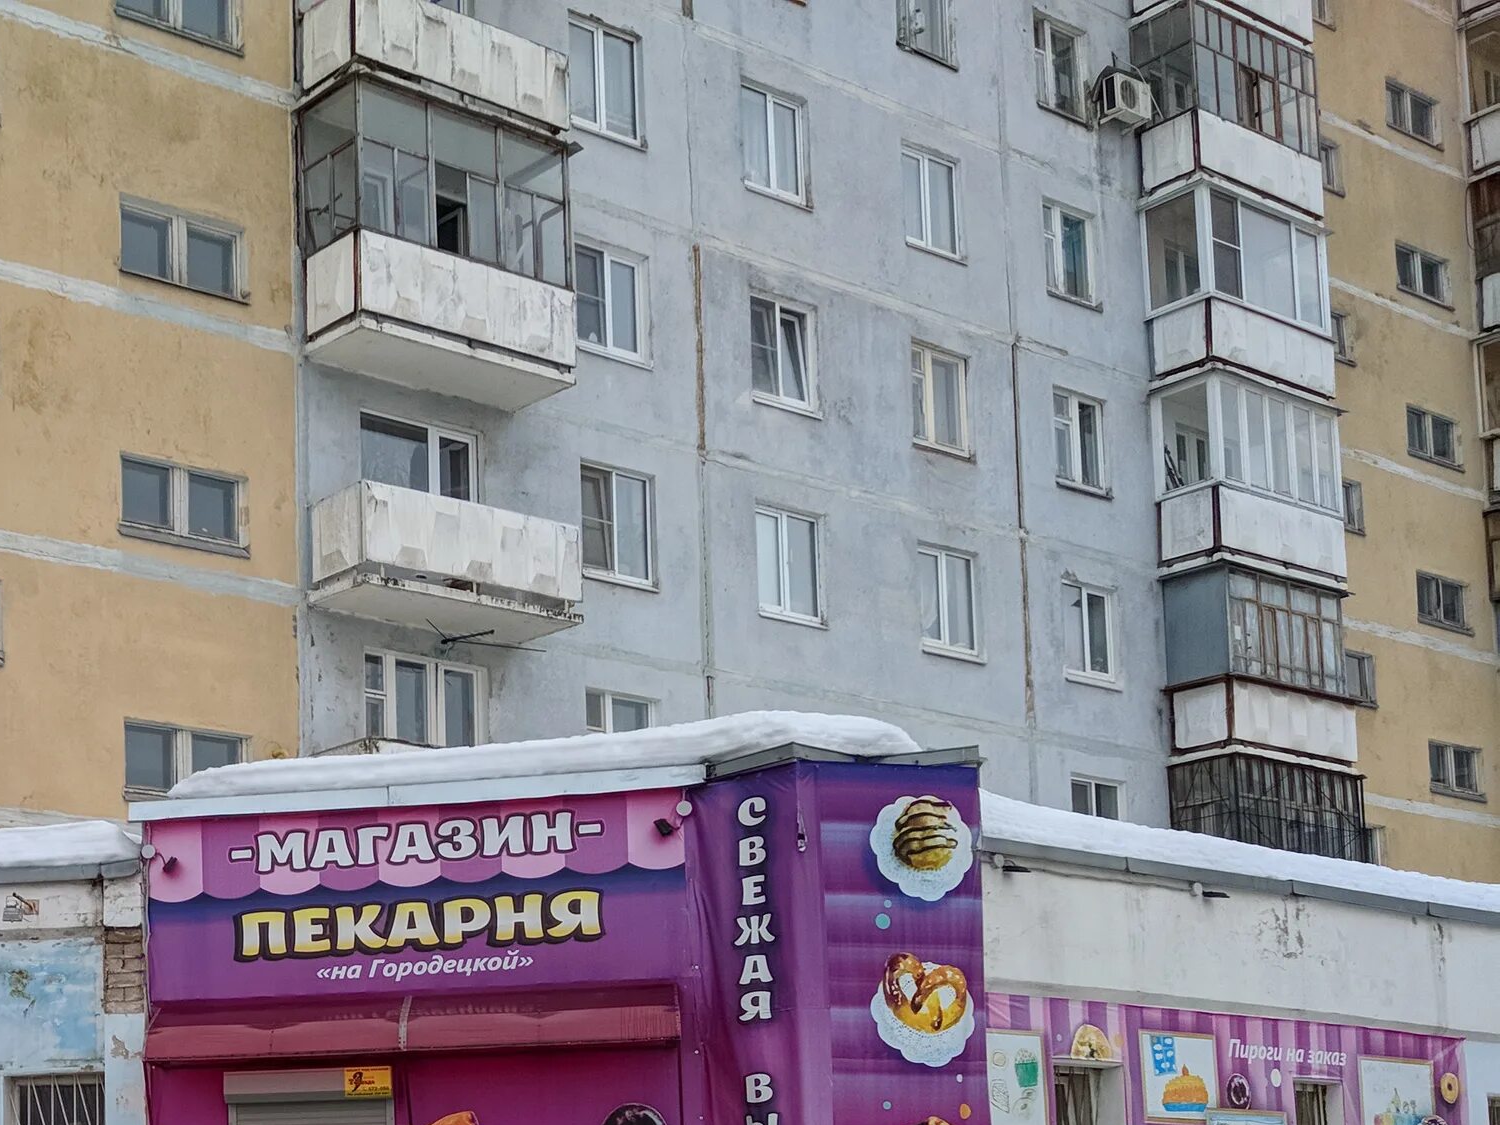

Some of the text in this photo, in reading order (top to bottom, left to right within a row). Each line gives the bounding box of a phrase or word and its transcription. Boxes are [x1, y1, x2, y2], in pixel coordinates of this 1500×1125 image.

[238, 889, 603, 957] ПЕКАРНЯ
[734, 796, 776, 1022] СВЕЖАЯ
[368, 949, 534, 982] Городецкой»
[1228, 1038, 1347, 1066] Пироги на заказ
